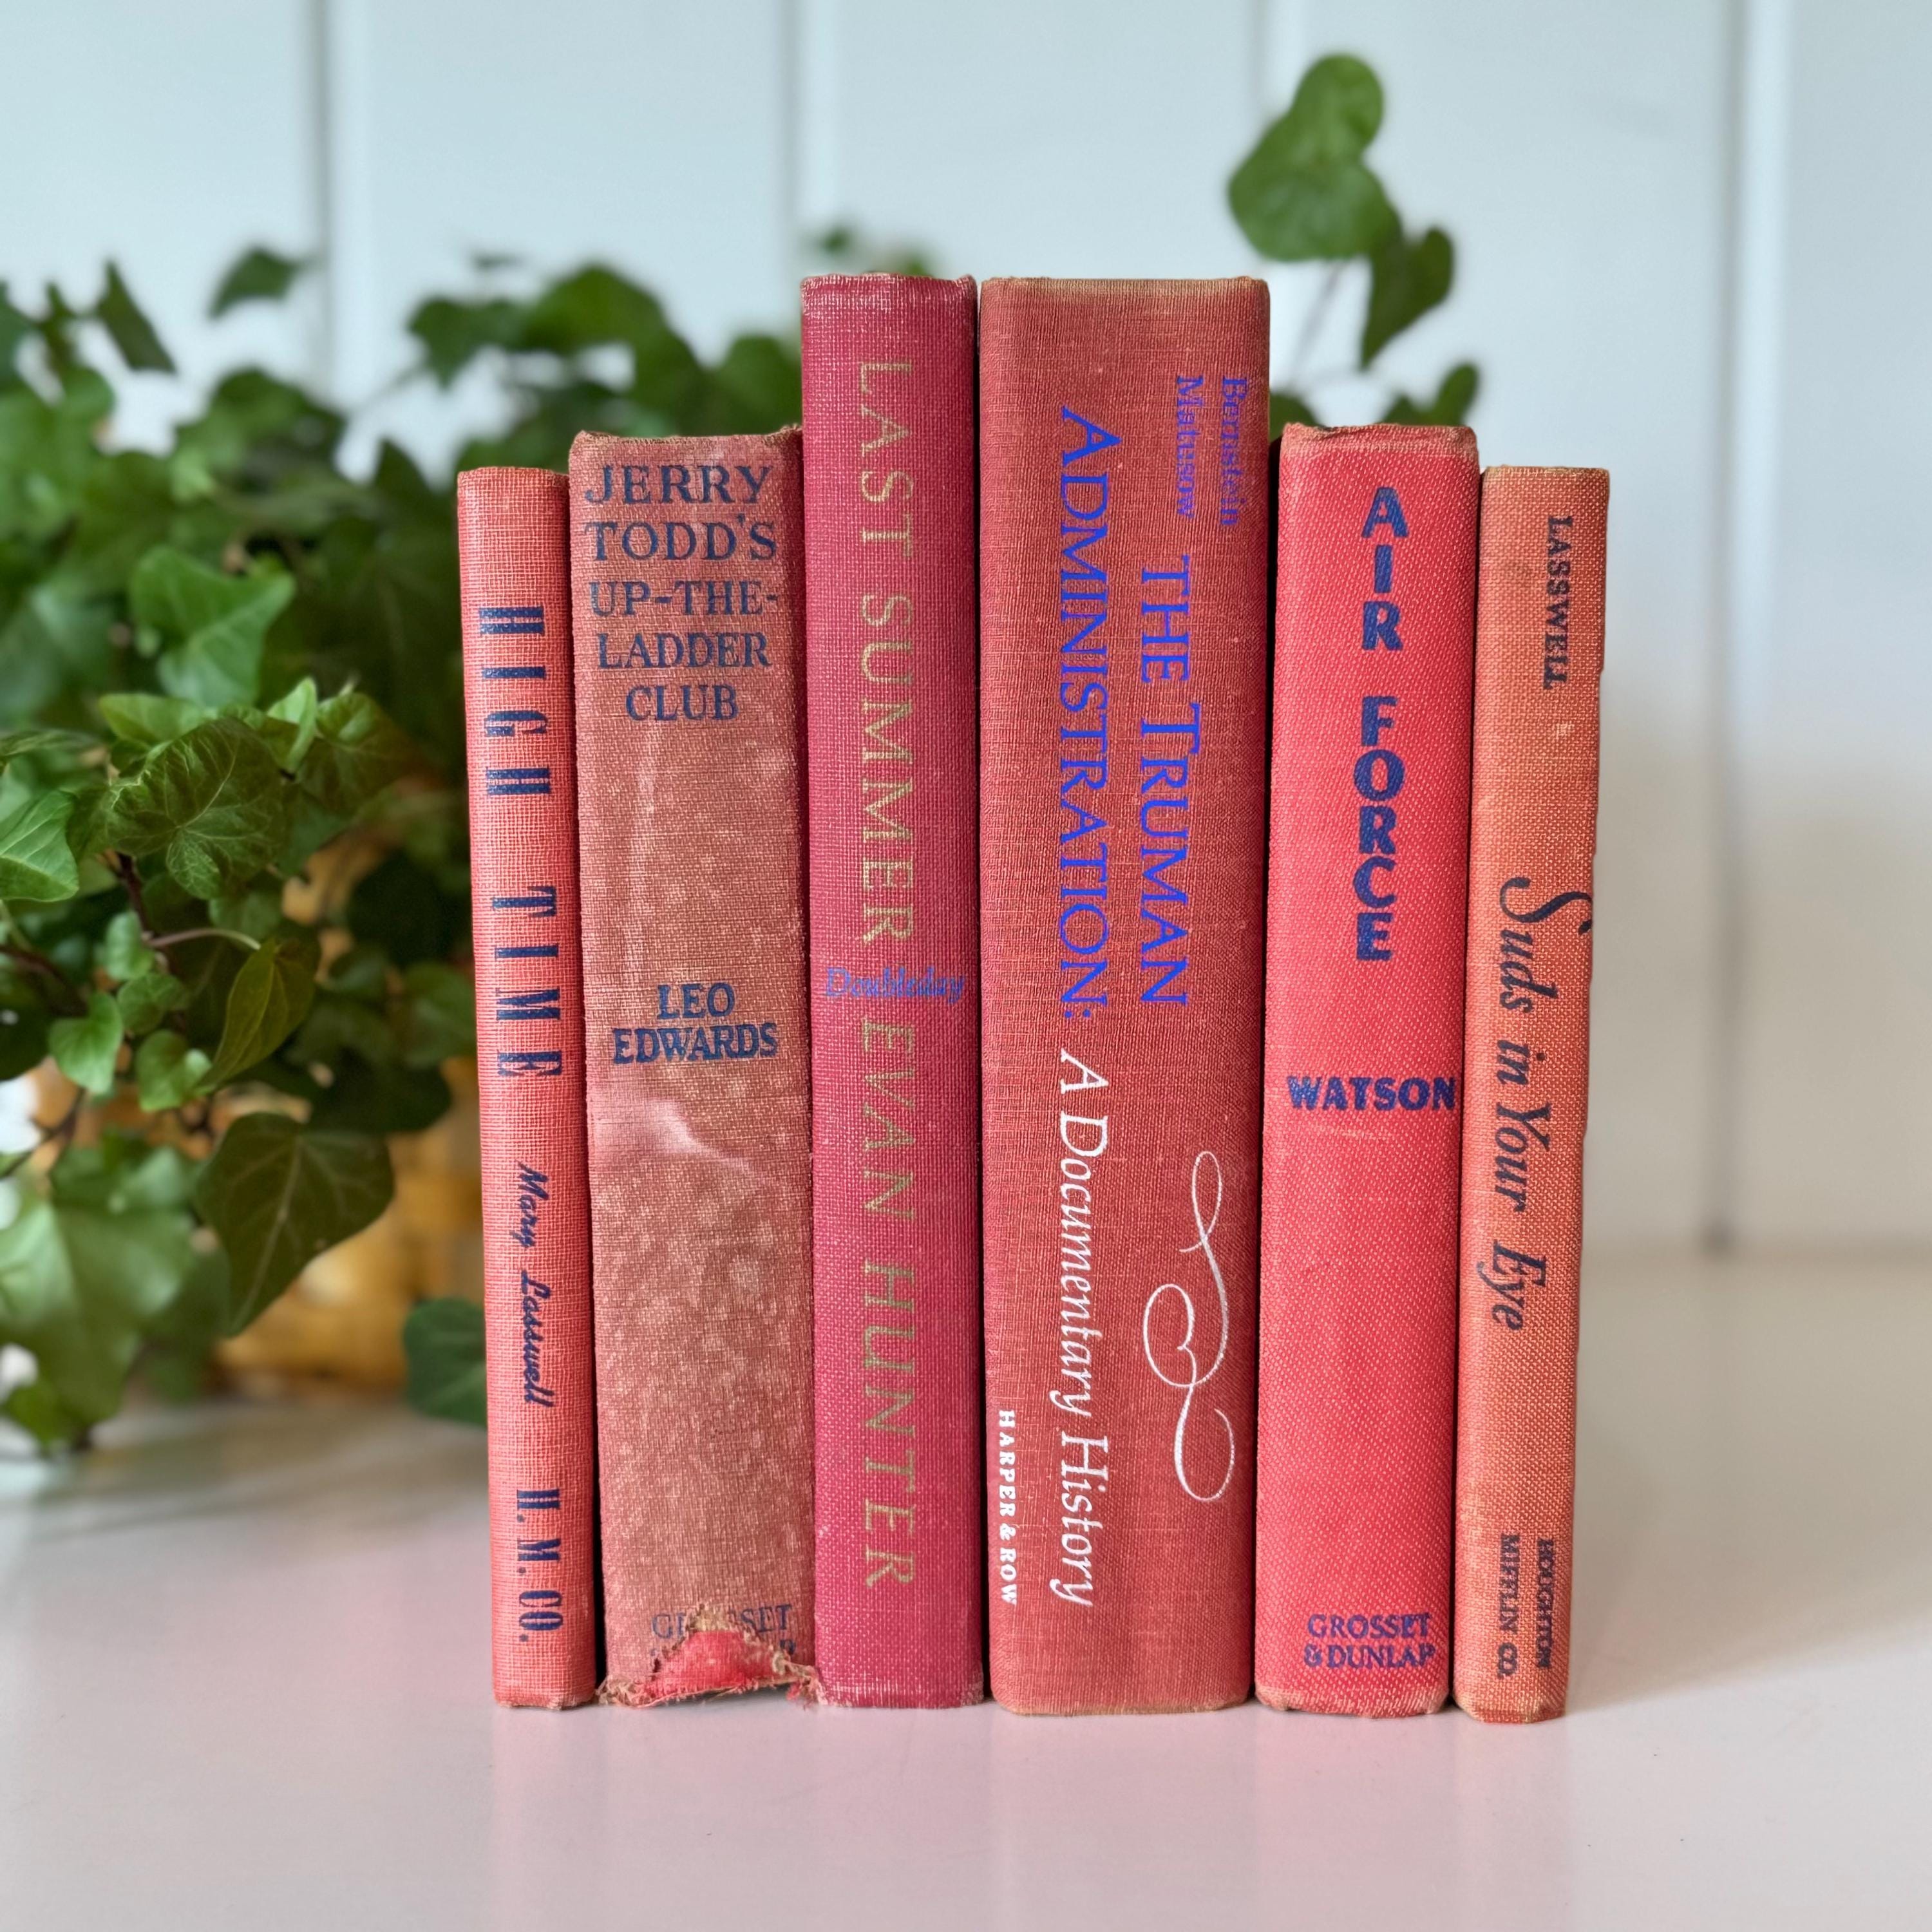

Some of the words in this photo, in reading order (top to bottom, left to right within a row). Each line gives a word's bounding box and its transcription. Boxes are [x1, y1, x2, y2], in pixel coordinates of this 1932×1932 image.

[585, 464, 773, 506] JERRY
[858, 362, 914, 558] LAST
[1176, 374, 1204, 519] Matusow
[1219, 374, 1248, 526] Bernstein
[584, 514, 778, 561] TODD'S
[1361, 486, 1410, 652] AIR
[596, 630, 773, 669] LADDER
[1141, 554, 1191, 683] THE
[1543, 515, 1574, 691] LASSWELL
[478, 605, 552, 796] HIGH
[625, 684, 740, 721] CLUB
[1060, 405, 1122, 1019] ADMINISTRATION:
[860, 592, 915, 945] SUMMER
[1141, 702, 1202, 1007] TRUMAN
[1352, 696, 1406, 961] FORCE
[492, 885, 563, 1076] TIME
[656, 982, 737, 1020] LEO
[826, 966, 965, 1005] Doubleday
[1498, 876, 1593, 1014] Suds
[612, 1022, 779, 1065] EDWARDS
[1060, 1047, 1109, 1095] A
[1288, 1075, 1458, 1112] WATSON
[1495, 1038, 1546, 1086] in
[862, 1016, 915, 1220] EVAN
[1494, 1103, 1552, 1213] Your
[509, 1160, 549, 1248] Mary
[1049, 1111, 1109, 1417] Documentary
[1476, 1238, 1547, 1331] Eye
[520, 1269, 555, 1408] Lasswell
[863, 1257, 916, 1588] HUNTER
[999, 1410, 1016, 1517] HARPER
[999, 1522, 1016, 1541] &
[999, 1547, 1018, 1606] ROW
[1049, 1430, 1109, 1607] History
[1303, 1643, 1323, 1668] &
[1325, 1643, 1437, 1669] DUNLAP
[1307, 1613, 1434, 1640] GROSSET
